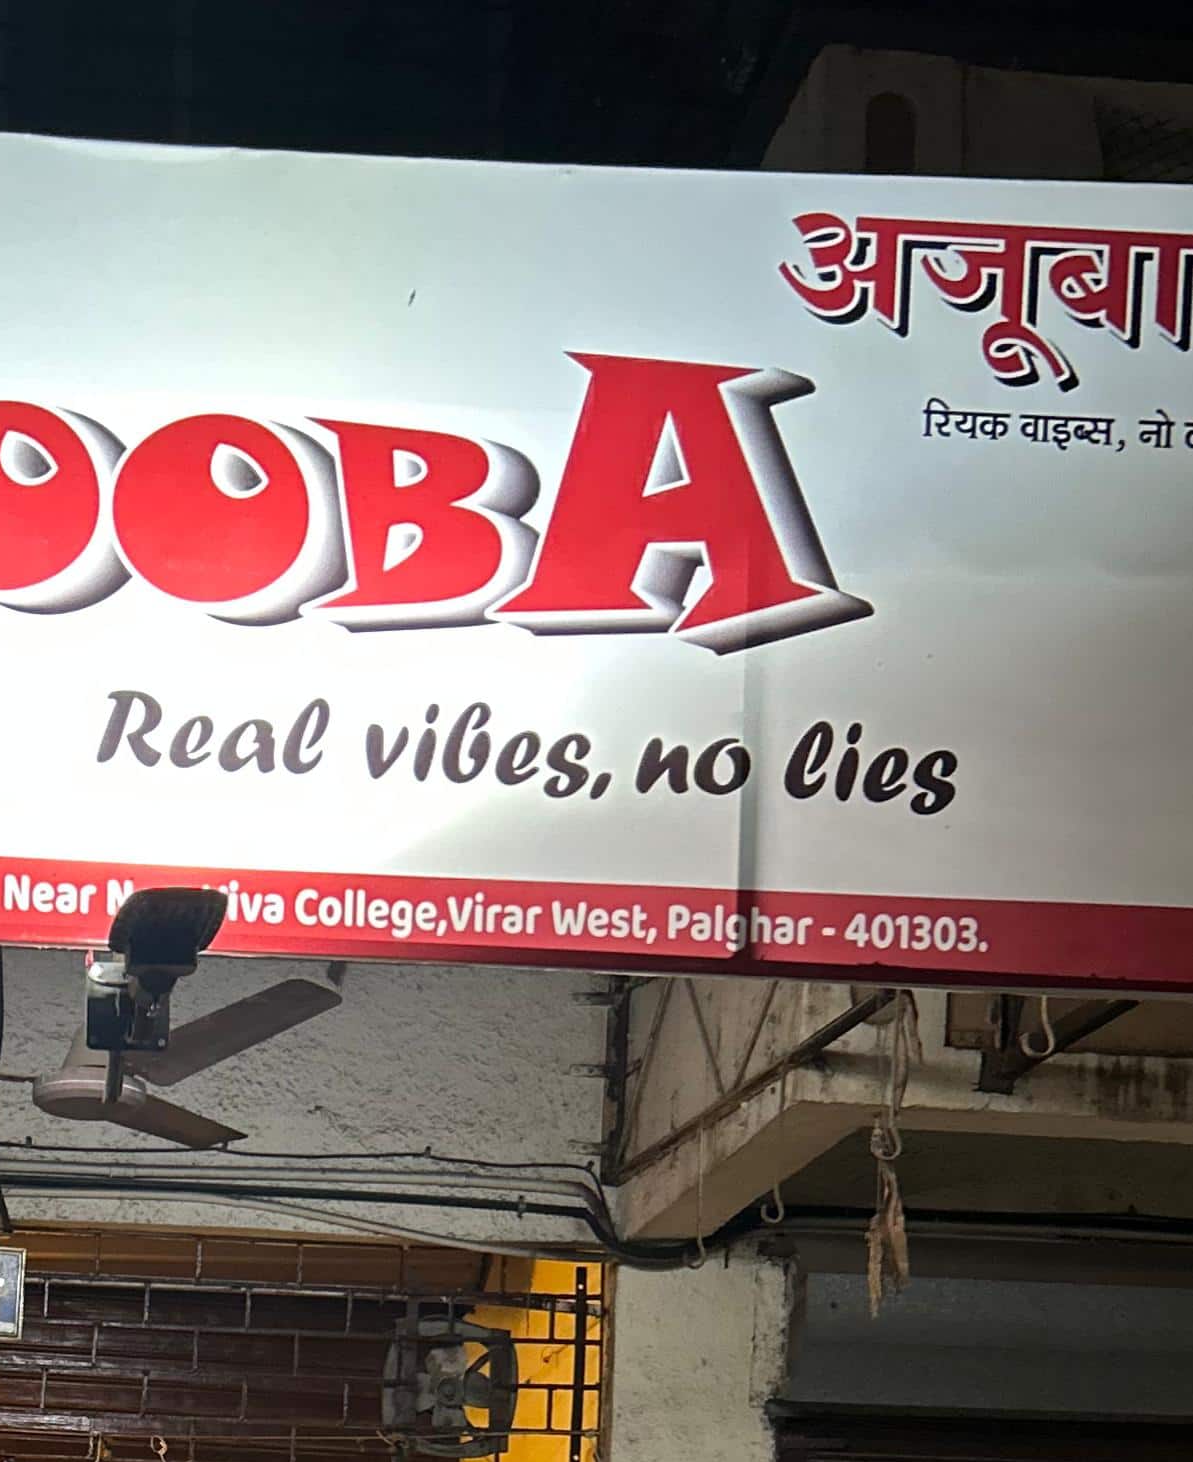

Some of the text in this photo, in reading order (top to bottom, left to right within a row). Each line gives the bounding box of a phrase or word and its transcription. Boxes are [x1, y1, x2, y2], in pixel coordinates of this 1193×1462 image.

[779, 212, 1193, 393] अजूबा
[1019, 413, 1125, 453] वाइब्स,
[1138, 409, 1175, 450] नो
[96, 689, 959, 816] Real vibes, no lies
[5, 873, 96, 914] Near
[201, 882, 285, 926] iva
[551, 900, 658, 945] West,
[668, 904, 813, 952] Palghar
[821, 926, 836, 938] -
[844, 912, 989, 953] 401303.
